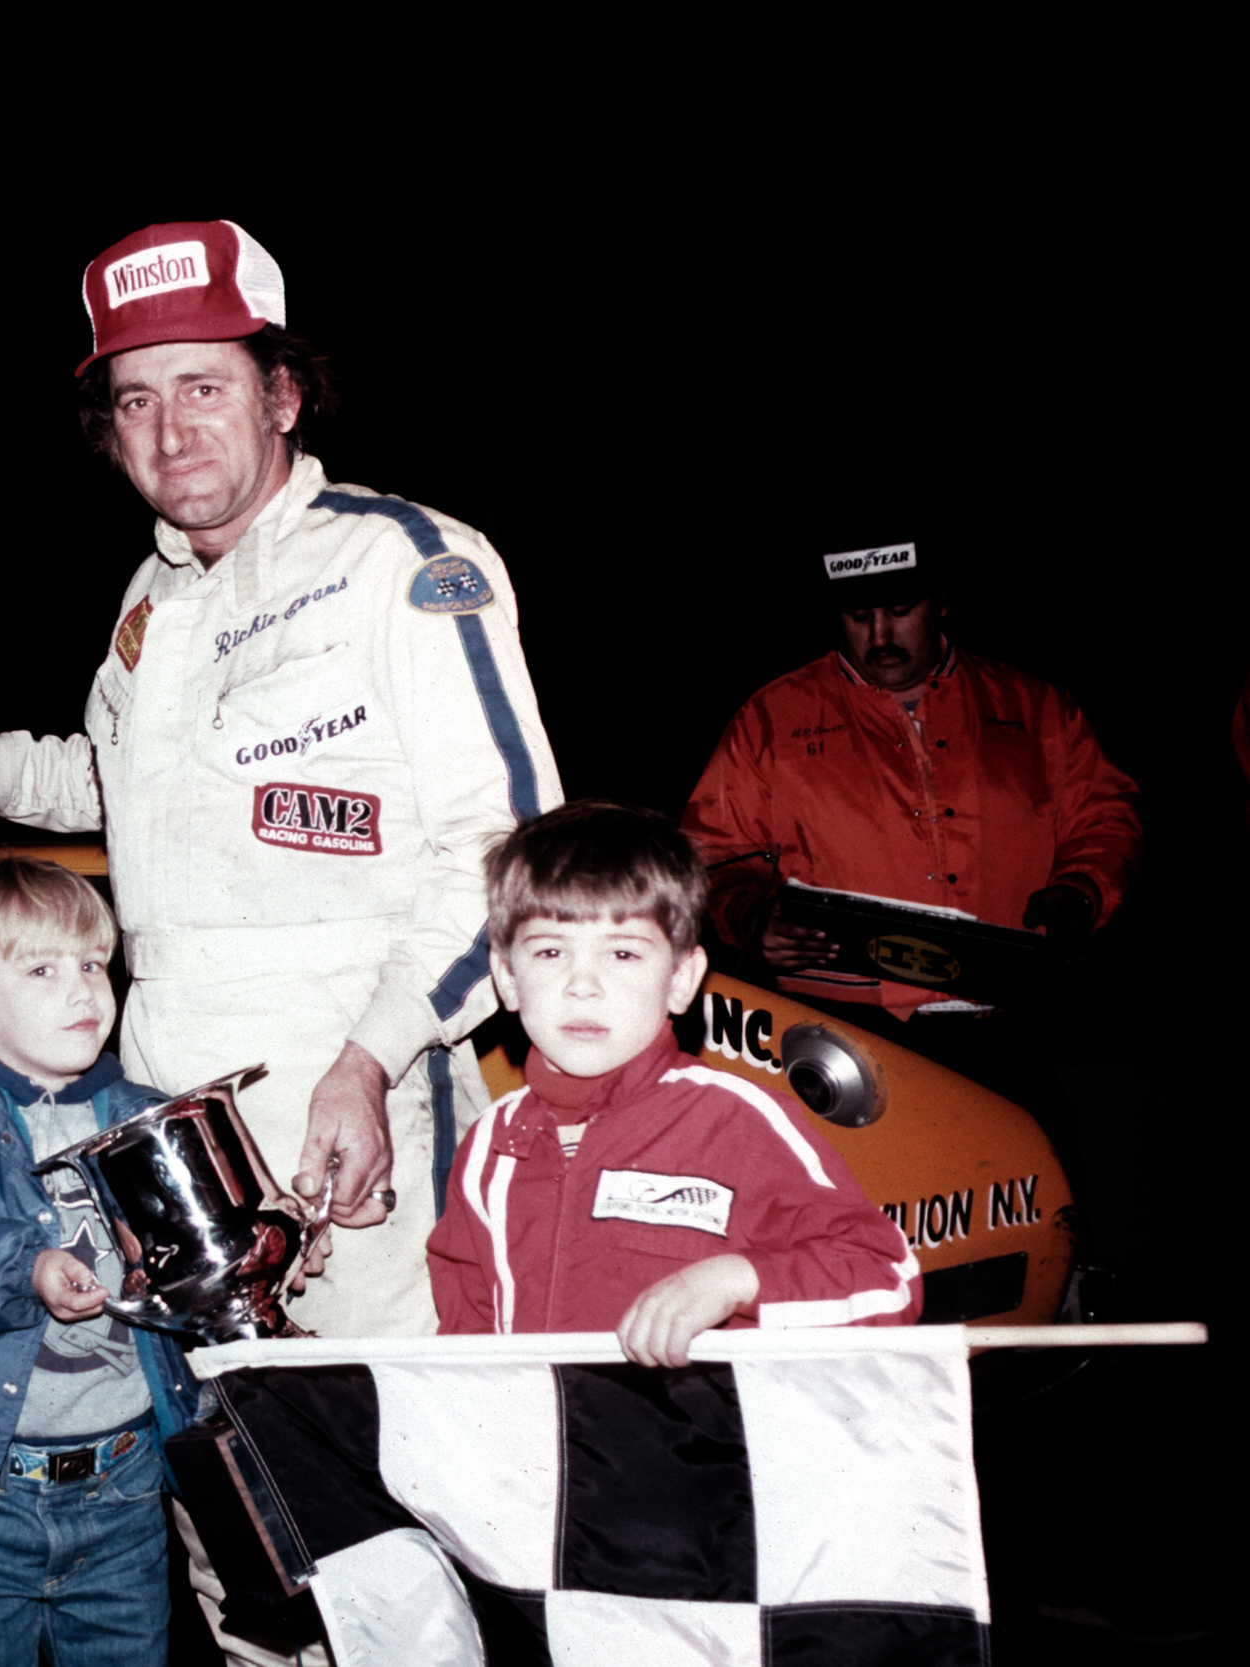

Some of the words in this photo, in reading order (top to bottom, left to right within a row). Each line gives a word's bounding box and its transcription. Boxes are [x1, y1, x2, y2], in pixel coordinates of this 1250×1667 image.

[112, 254, 196, 298] Winston
[214, 613, 277, 663] Richie
[283, 576, 348, 621] Evans
[261, 788, 373, 838] CAM2
[258, 827, 308, 845] RACING
[312, 834, 376, 852] GASOLINE
[989, 1175, 1041, 1231] N.Y.
